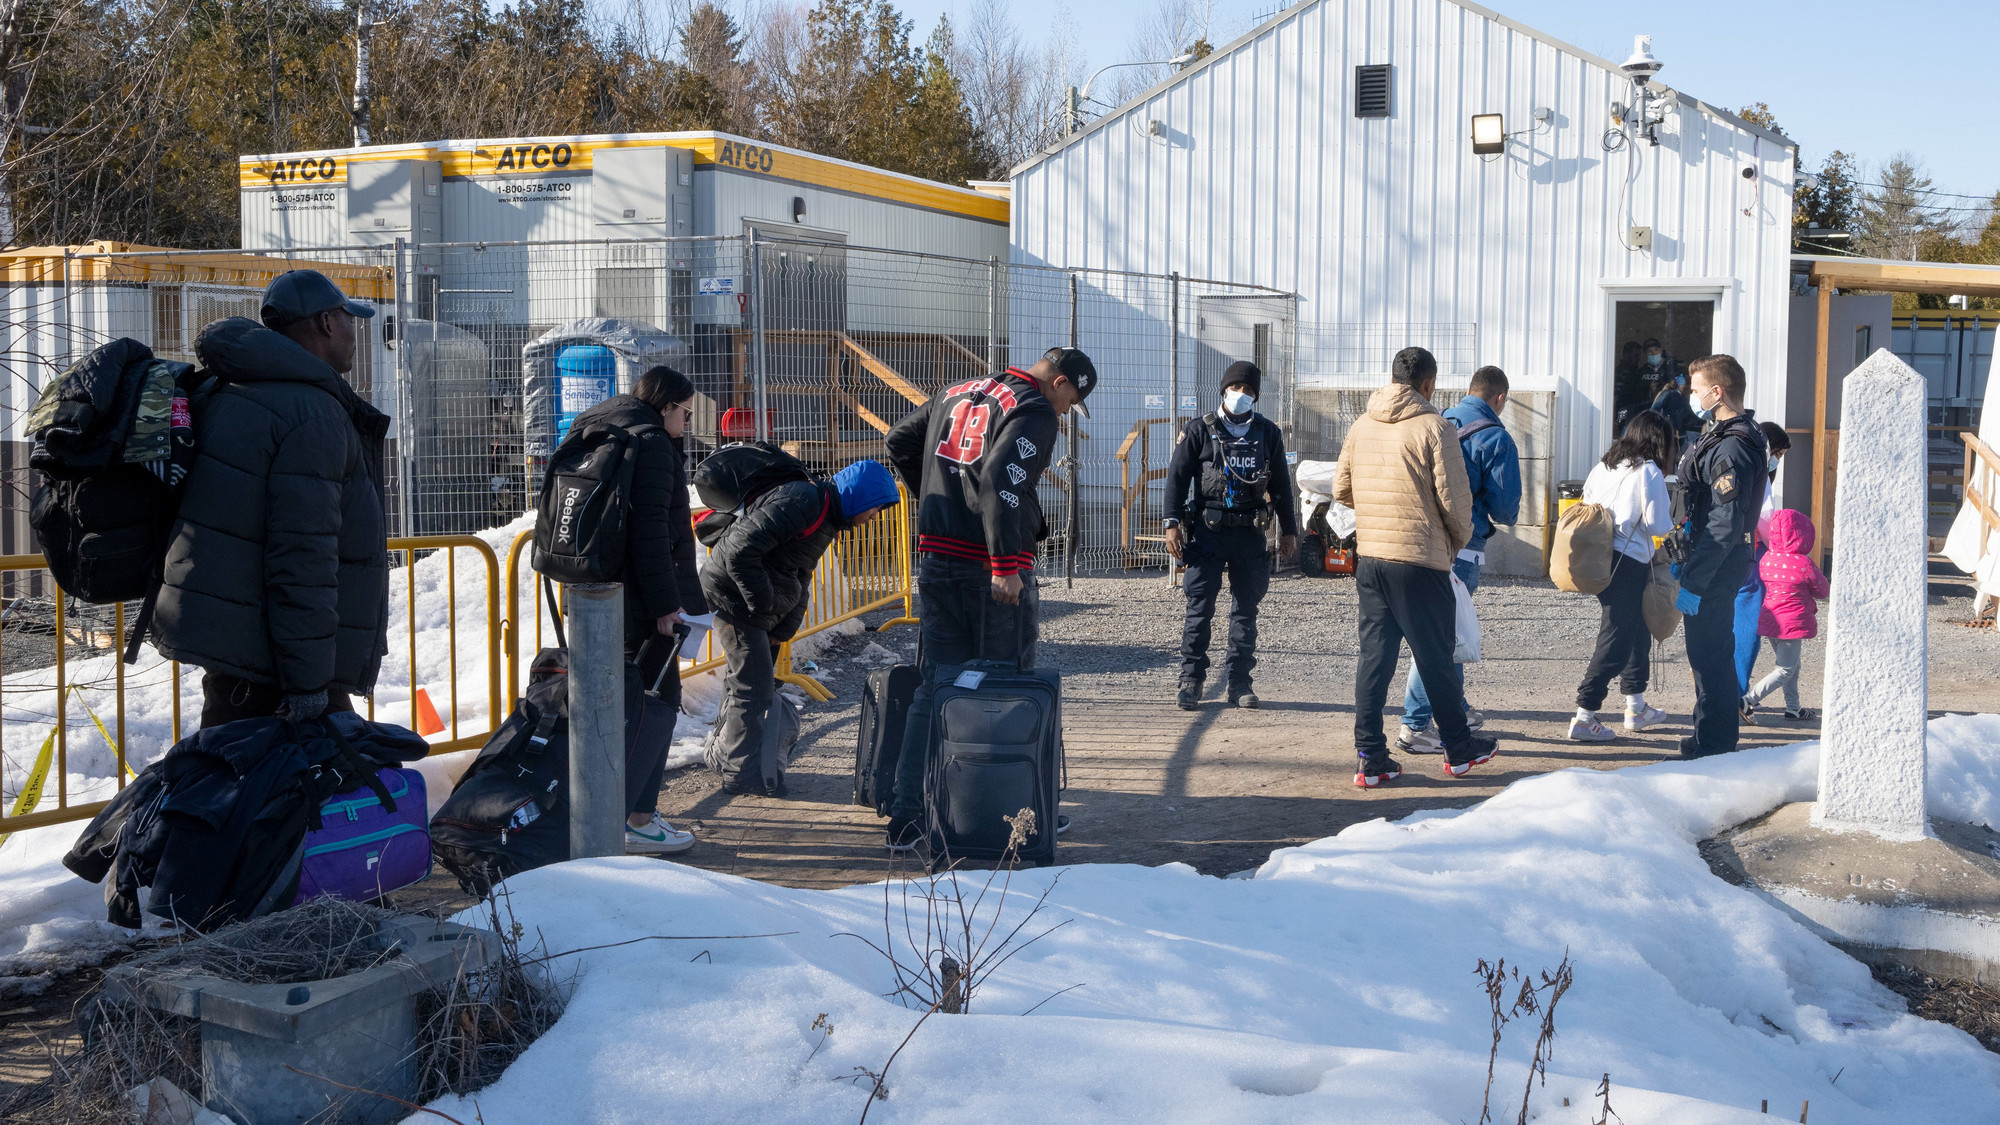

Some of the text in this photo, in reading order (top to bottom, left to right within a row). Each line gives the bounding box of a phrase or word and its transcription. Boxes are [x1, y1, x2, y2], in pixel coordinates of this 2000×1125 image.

[496, 144, 572, 170] ATCO
[719, 139, 773, 172] ATCO
[270, 157, 336, 182] ATCO
[270, 193, 335, 203] 1-800-575-ATCO
[497, 183, 571, 193] 1-800-575-ATCO
[558, 487, 580, 544] Reebok
